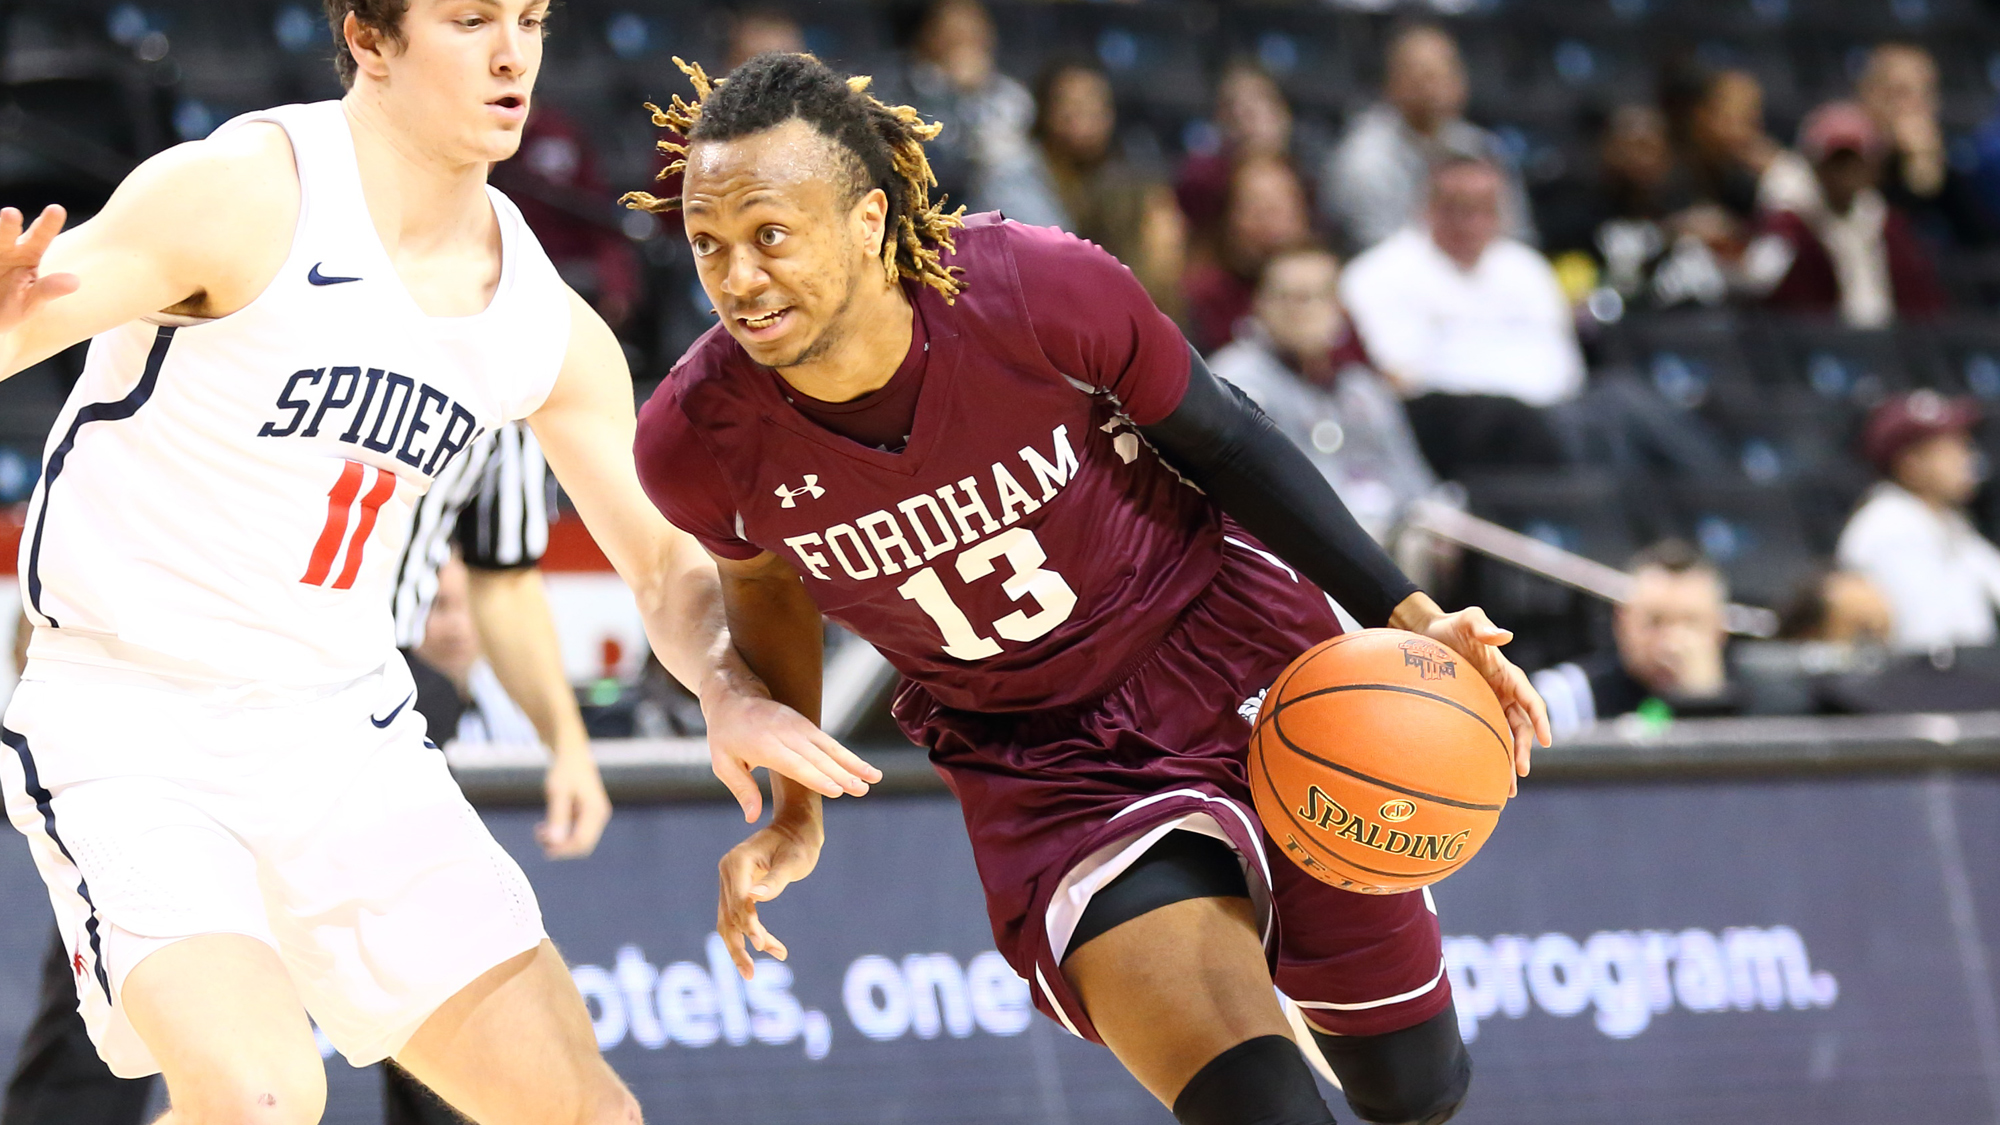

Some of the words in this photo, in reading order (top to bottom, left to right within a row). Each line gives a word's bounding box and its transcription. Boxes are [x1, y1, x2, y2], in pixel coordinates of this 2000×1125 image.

[257, 366, 485, 478] SPIDER
[299, 459, 397, 591] 11
[783, 424, 1080, 581] FORDHAM
[896, 526, 1078, 661] 13
[1298, 784, 1472, 861] SPALDING
[568, 931, 833, 1060] otels,
[842, 950, 1032, 1041] one
[1441, 925, 1839, 1045] program.
